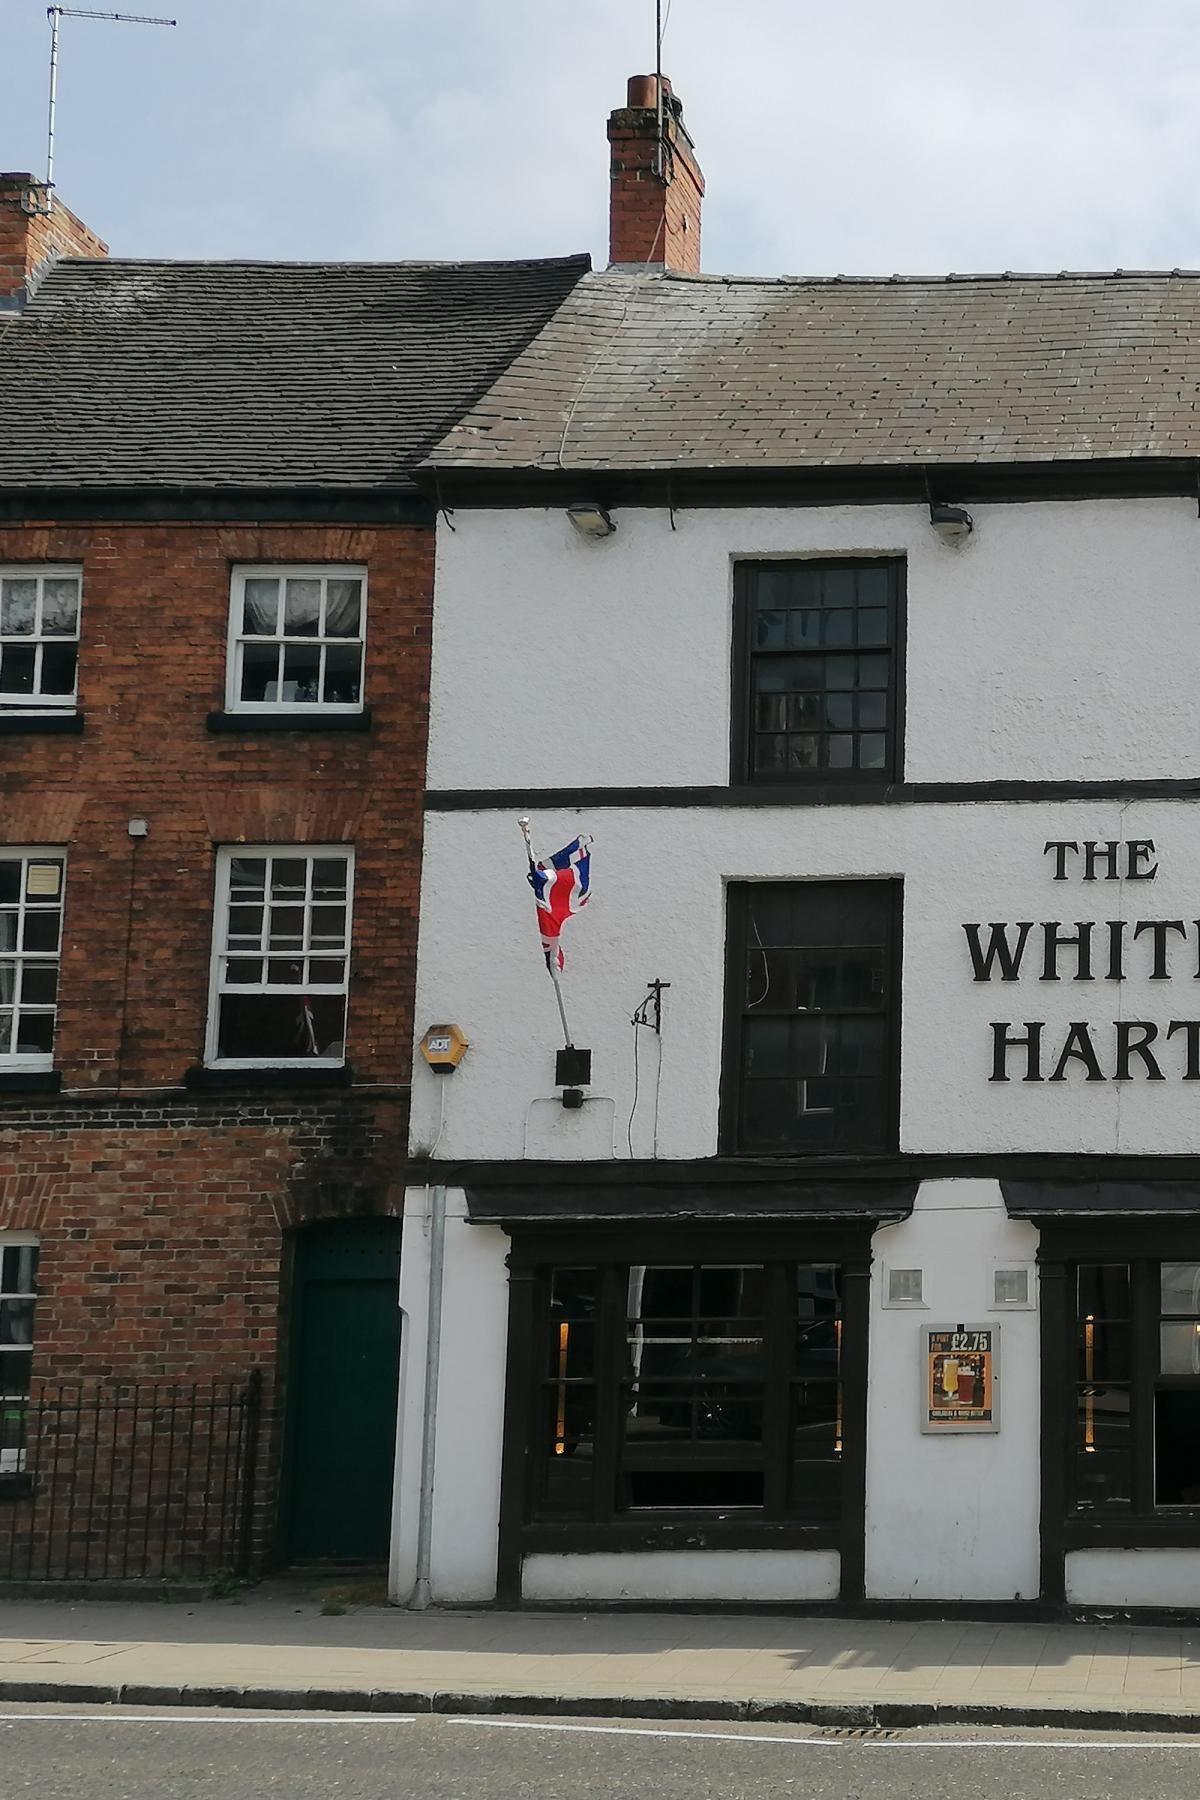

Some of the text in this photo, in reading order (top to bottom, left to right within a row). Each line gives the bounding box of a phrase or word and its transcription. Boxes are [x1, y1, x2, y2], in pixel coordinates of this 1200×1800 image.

[1043, 839, 1159, 881] THE
[428, 1039, 450, 1049] ADT
[950, 1333, 987, 1351] £2.75
